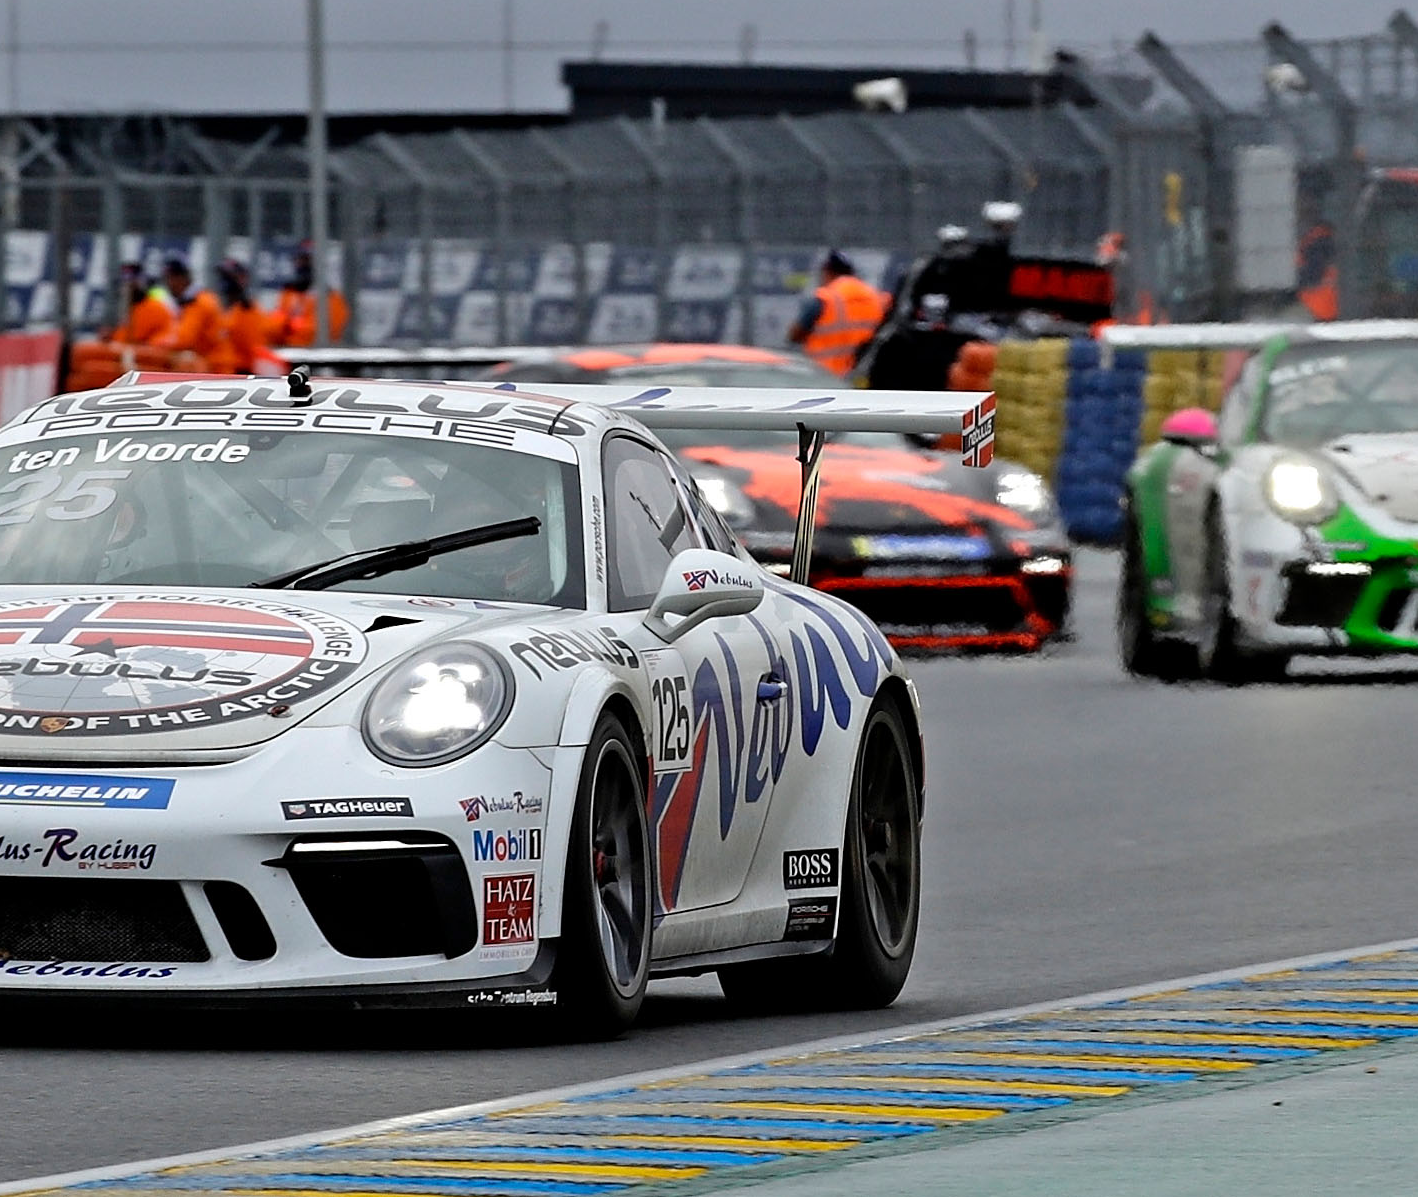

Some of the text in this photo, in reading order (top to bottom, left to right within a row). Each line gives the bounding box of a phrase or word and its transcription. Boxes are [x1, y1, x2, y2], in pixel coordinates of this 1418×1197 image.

[39, 411, 517, 448] PORSCHE
[8, 446, 80, 475] ten
[93, 437, 250, 463] Voorde
[136, 594, 255, 607] POLAR
[255, 603, 354, 659] CHALLENGE
[60, 715, 111, 730] OF
[117, 707, 212, 728] THE
[219, 660, 341, 719] ARCTIC
[651, 675, 690, 762] 125
[473, 829, 526, 862] Mobil
[788, 853, 831, 878] BOSS
[486, 877, 533, 904] HATZ
[486, 918, 533, 941] TEAM
